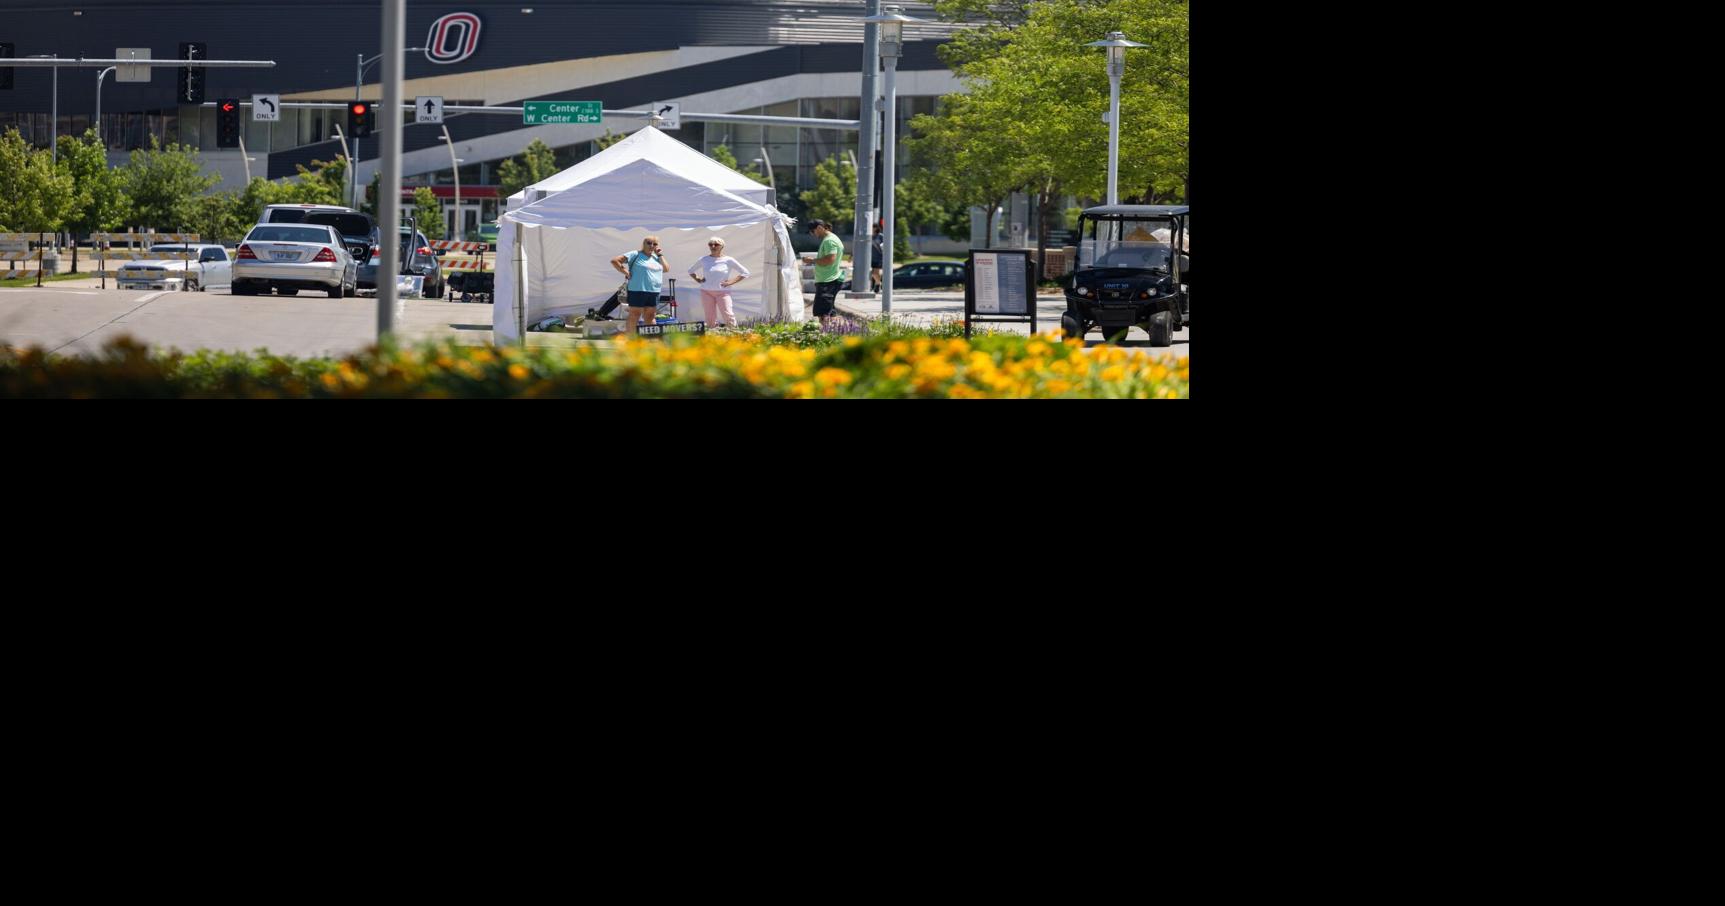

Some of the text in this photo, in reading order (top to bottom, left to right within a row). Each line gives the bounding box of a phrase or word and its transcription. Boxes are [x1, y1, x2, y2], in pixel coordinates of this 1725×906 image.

[425, 12, 481, 64] O
[549, 104, 579, 112] Center
[527, 114, 589, 122] W Center Rd
[639, 323, 703, 335] NEED MOVERS?
